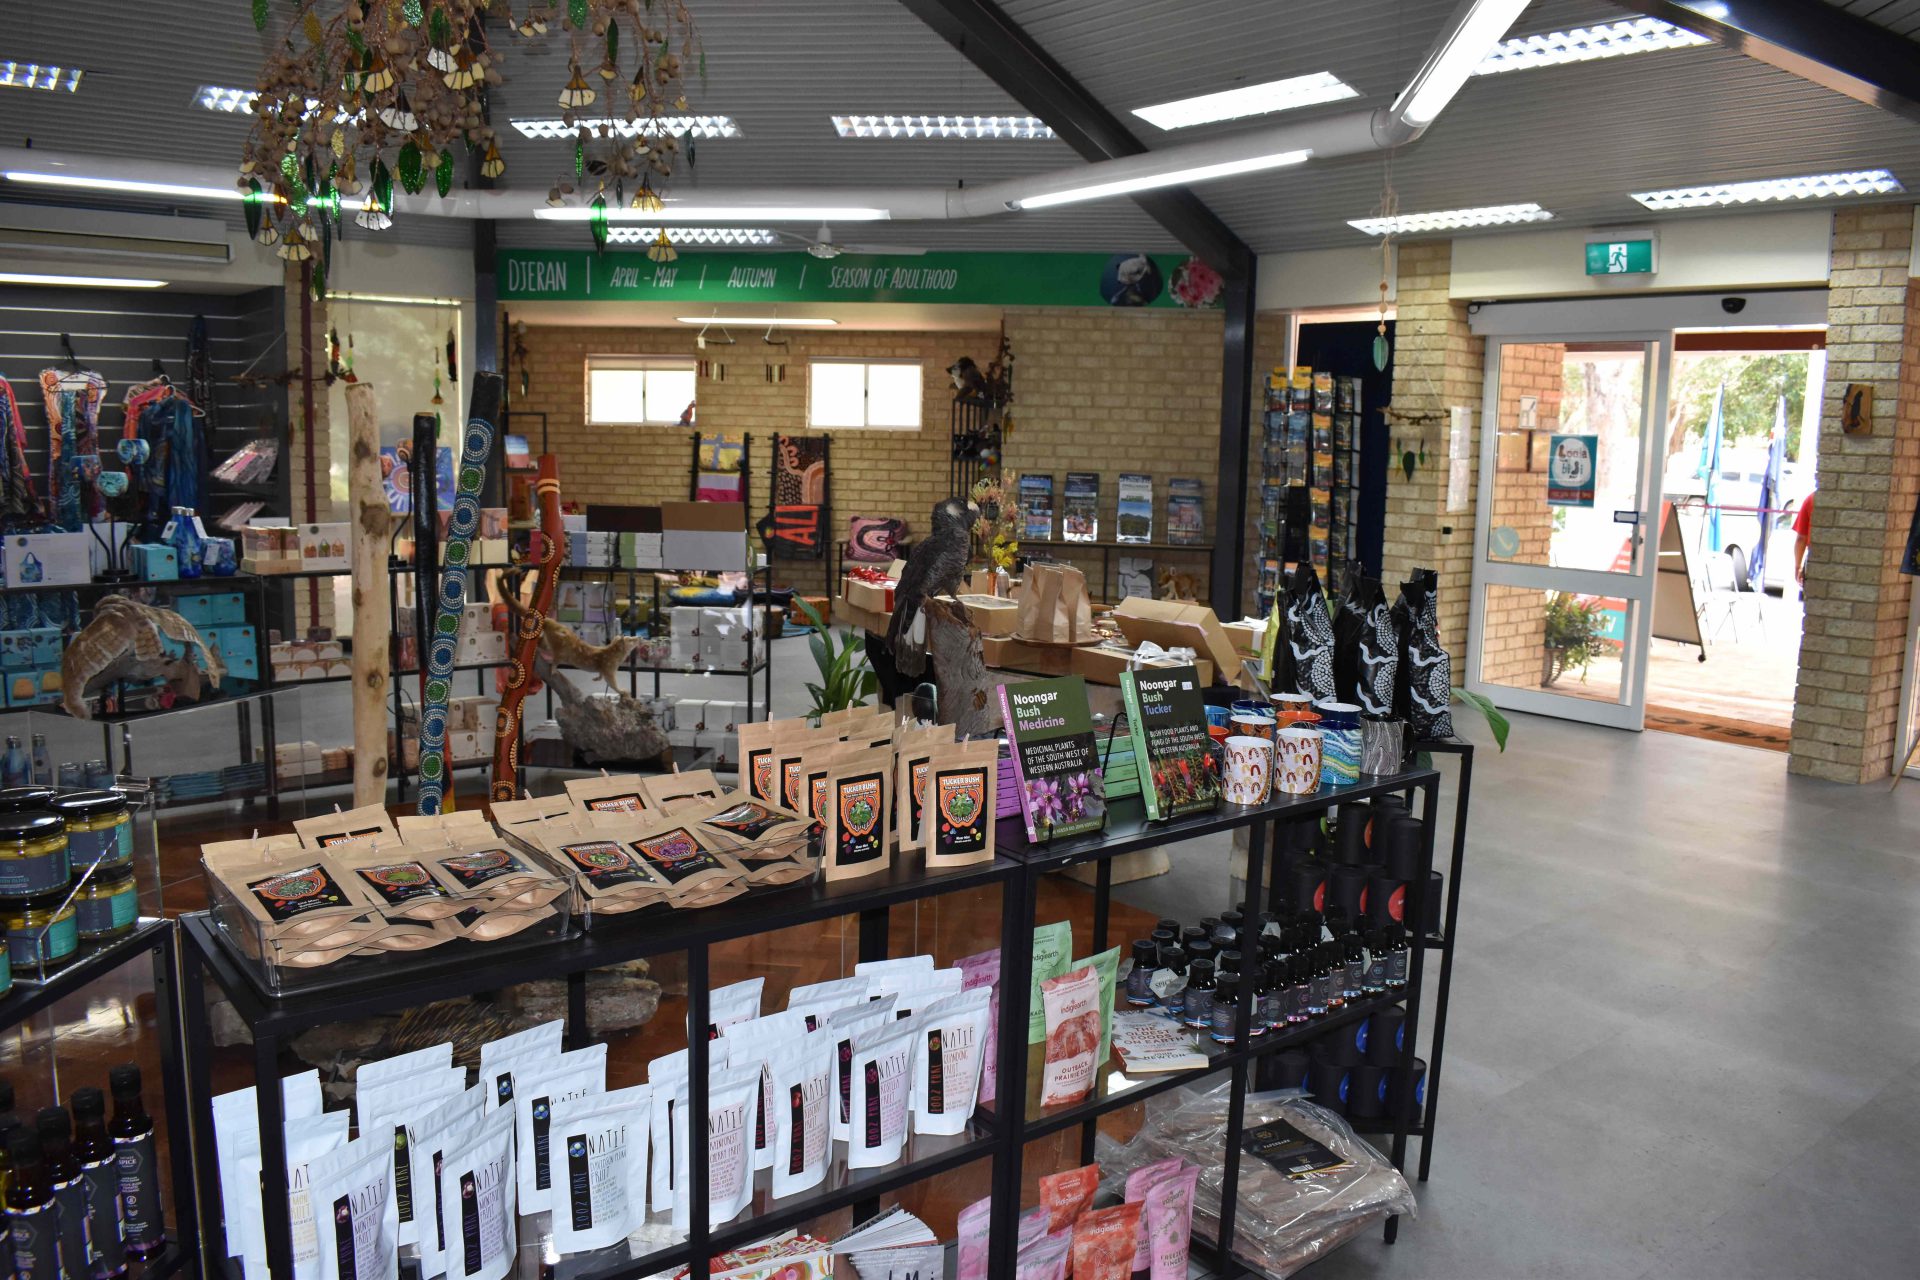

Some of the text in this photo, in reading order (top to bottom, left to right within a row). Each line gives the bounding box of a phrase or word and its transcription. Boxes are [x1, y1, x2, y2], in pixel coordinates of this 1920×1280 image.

[508, 259, 567, 291] DJERAN
[610, 266, 639, 288] APRIL
[652, 266, 679, 288] MAY
[727, 266, 777, 289] AUTUMN
[828, 266, 958, 289] SEASON OF ADULTHOOD
[1139, 679, 1177, 691] Noongar
[1013, 691, 1058, 705] Noongar
[1142, 691, 1163, 703] Bush
[1016, 705, 1041, 718] Bush
[1144, 704, 1172, 715] Tucker
[1018, 716, 1065, 732] Medicine
[1174, 725, 1190, 735] PLANTS
[1189, 724, 1199, 732] AND
[1025, 740, 1076, 756] MEDICINAL PLANTS
[1164, 737, 1171, 745] OF
[1152, 742, 1201, 756] OF WESTERN AUSTRALIA
[1027, 757, 1035, 766] OF
[1035, 755, 1046, 764] THE
[1081, 747, 1089, 757] OF
[1029, 758, 1084, 775] WESTERN AUSTRALIA
[843, 785, 862, 794] TUCKER
[862, 782, 877, 791] BUSH
[943, 777, 964, 785] TUCKER
[595, 801, 619, 809] TUCKER
[640, 831, 681, 847] TUCKER BUSH
[1033, 950, 1059, 964] ndigiearth
[942, 1026, 974, 1049] NATIF
[1061, 1061, 1088, 1074] OUTBACK
[709, 1107, 743, 1134] NATIF
[588, 1125, 626, 1156] NATIF
